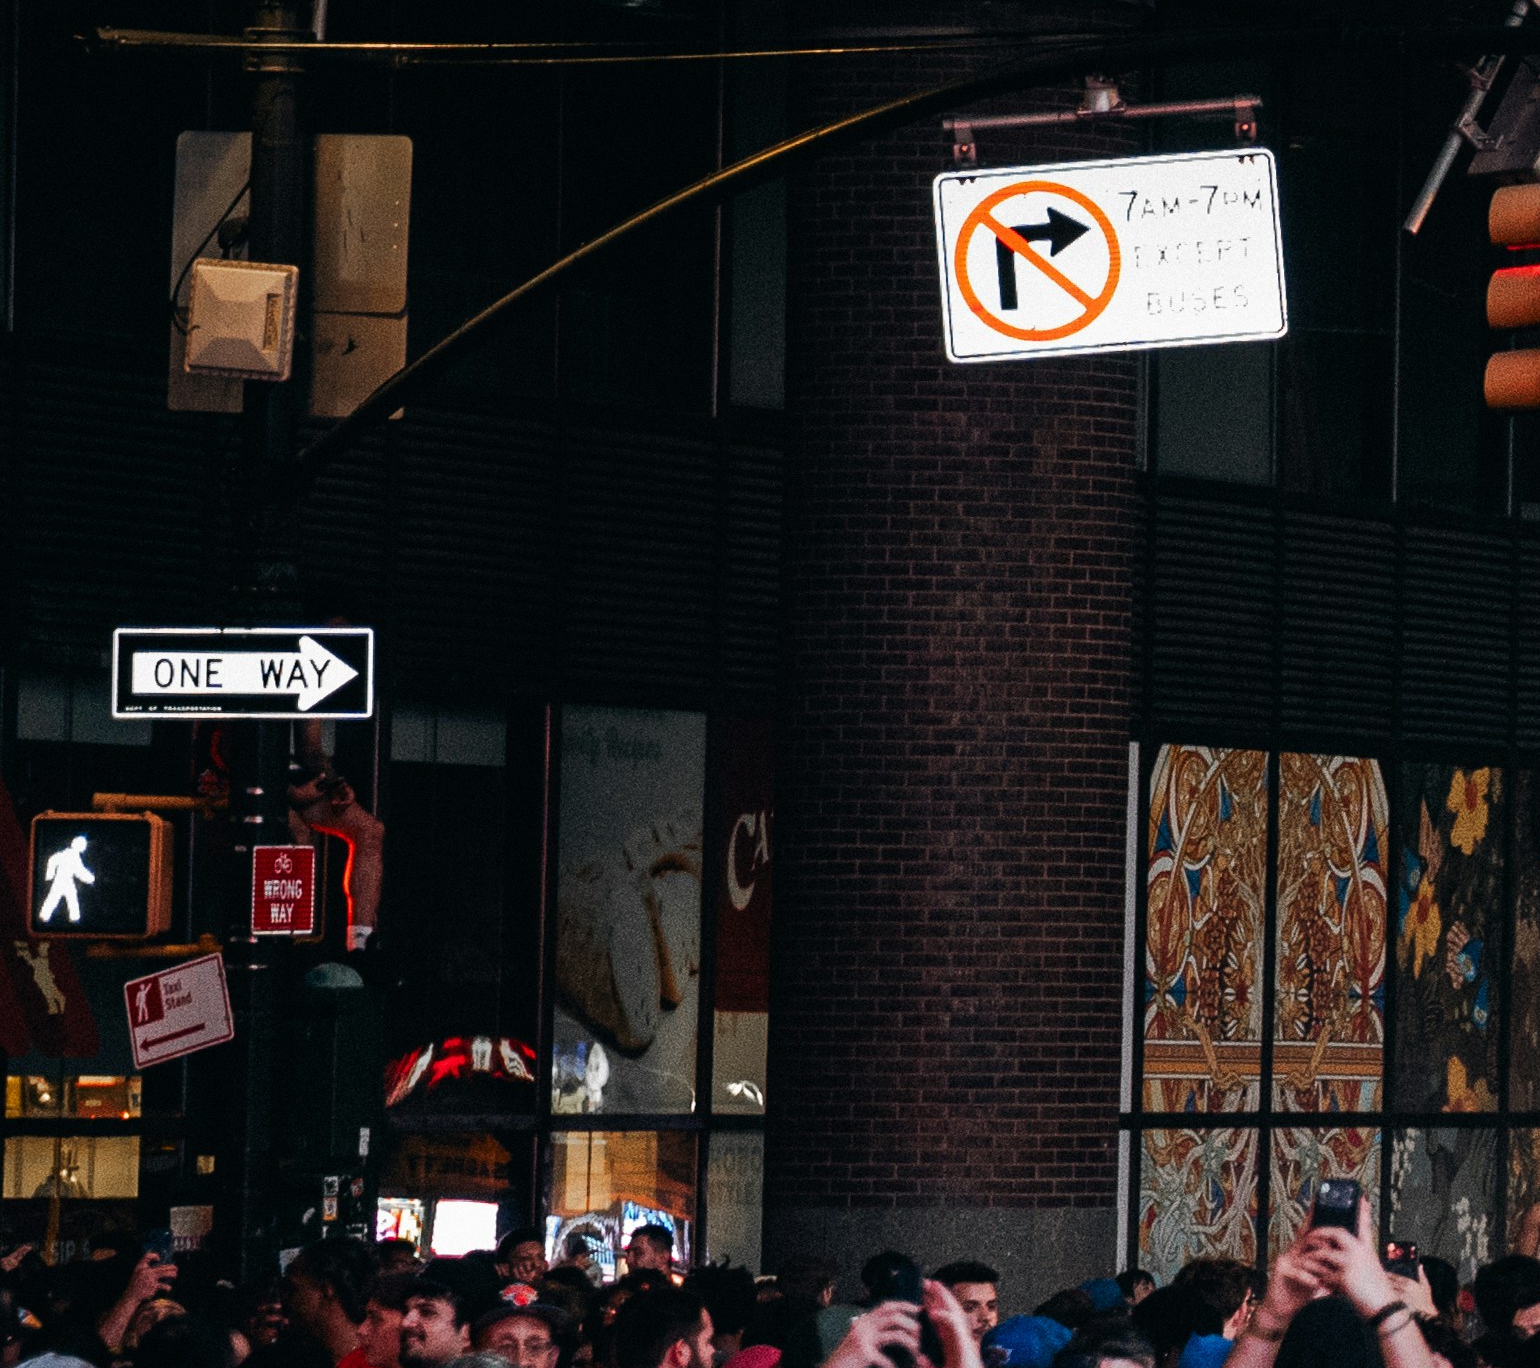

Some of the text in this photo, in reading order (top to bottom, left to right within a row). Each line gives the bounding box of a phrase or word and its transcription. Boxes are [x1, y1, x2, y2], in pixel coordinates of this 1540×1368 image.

[1147, 284, 1249, 316] BUSES
[155, 659, 331, 689] ONE WAY
[263, 880, 303, 900] WRONG
[270, 903, 294, 923] WAY
[164, 991, 191, 1010] Stand
